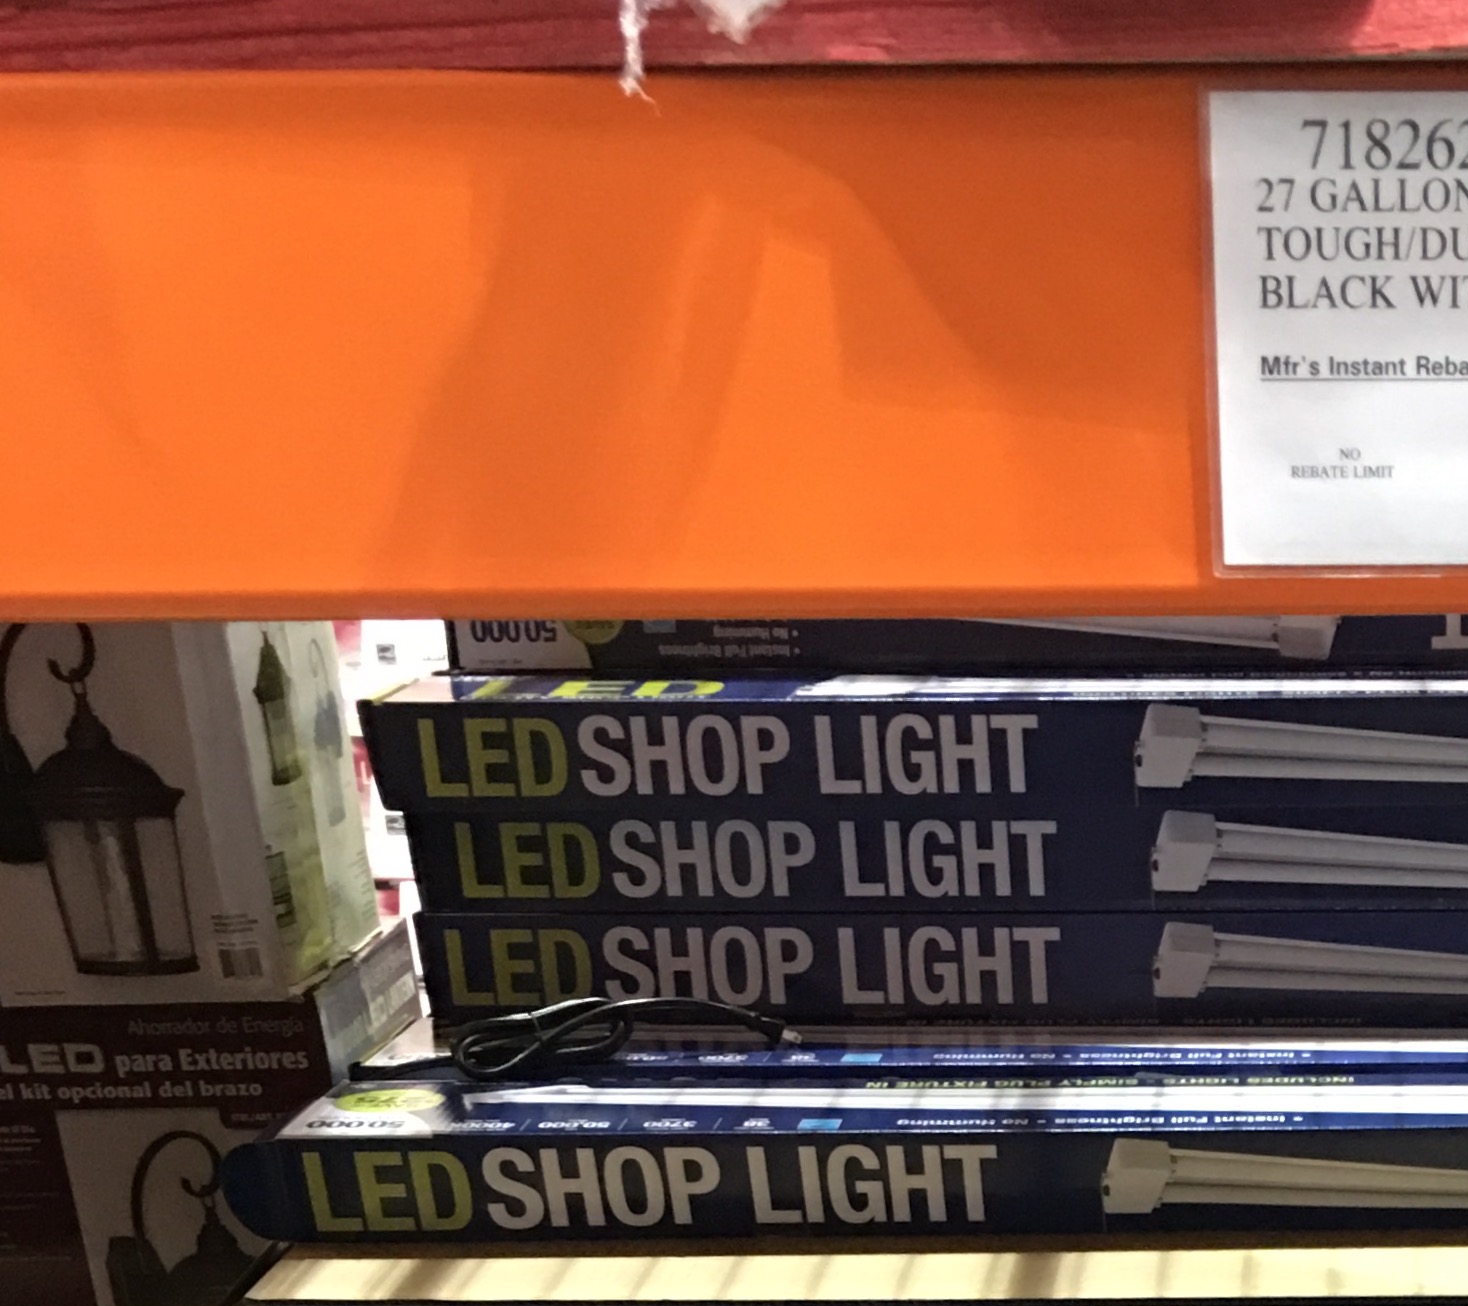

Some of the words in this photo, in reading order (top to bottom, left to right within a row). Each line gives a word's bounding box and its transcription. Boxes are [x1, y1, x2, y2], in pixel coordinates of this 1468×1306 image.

[1256, 178, 1295, 213] 27
[1259, 275, 1398, 309] BLACK
[1261, 355, 1321, 377] Mfr's
[1329, 355, 1407, 377] Instant
[1338, 447, 1361, 460] NO
[1291, 465, 1355, 479] REBATE
[1359, 465, 1394, 479] LIMIT
[417, 716, 568, 799] LED
[577, 714, 791, 797] SHOP
[814, 713, 1039, 796] LIGHT
[454, 821, 600, 899] LED
[608, 819, 817, 899] SHOP
[838, 819, 1058, 899] LIGHT
[443, 928, 593, 1007] LED
[602, 926, 814, 1006] SHOP
[837, 926, 1061, 1006] LIGHT
[0, 1042, 105, 1074] LED
[115, 1052, 173, 1079] para
[181, 1047, 309, 1071] Exteriores
[21, 1083, 50, 1100] kit
[57, 1081, 151, 1104] opcional
[159, 1081, 193, 1098] del
[199, 1080, 263, 1097] brazo
[300, 1150, 473, 1233] LED
[480, 1146, 721, 1230] SHOP
[746, 1144, 999, 1226] LIGHT
